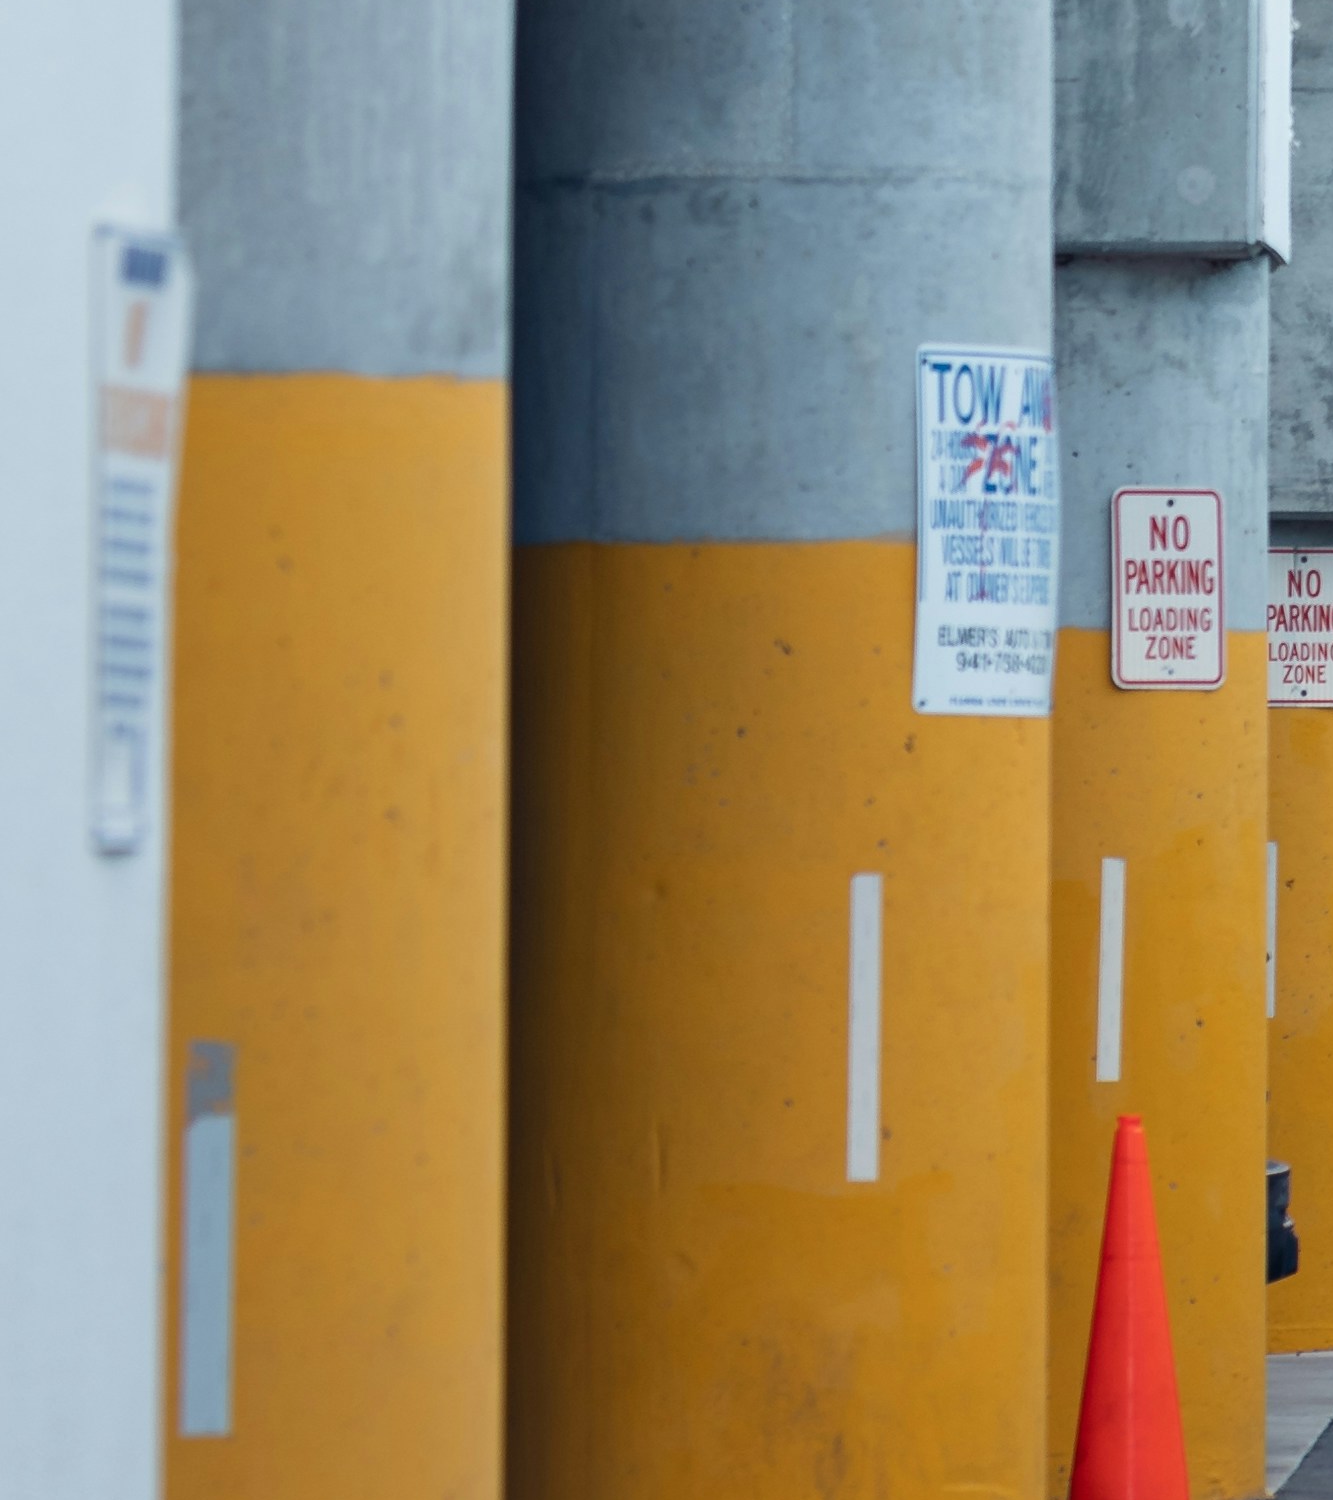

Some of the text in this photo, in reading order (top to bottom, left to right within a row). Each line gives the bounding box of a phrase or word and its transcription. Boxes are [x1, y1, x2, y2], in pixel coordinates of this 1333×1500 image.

[930, 362, 1005, 424] TOW
[1150, 516, 1190, 551] NO
[1124, 559, 1215, 596] PARKING
[1287, 569, 1322, 598] NO
[1128, 607, 1213, 632] LOADING
[937, 624, 998, 648] ELMER'S
[1144, 636, 1197, 660] ZONE
[1282, 664, 1327, 684] ZONE
